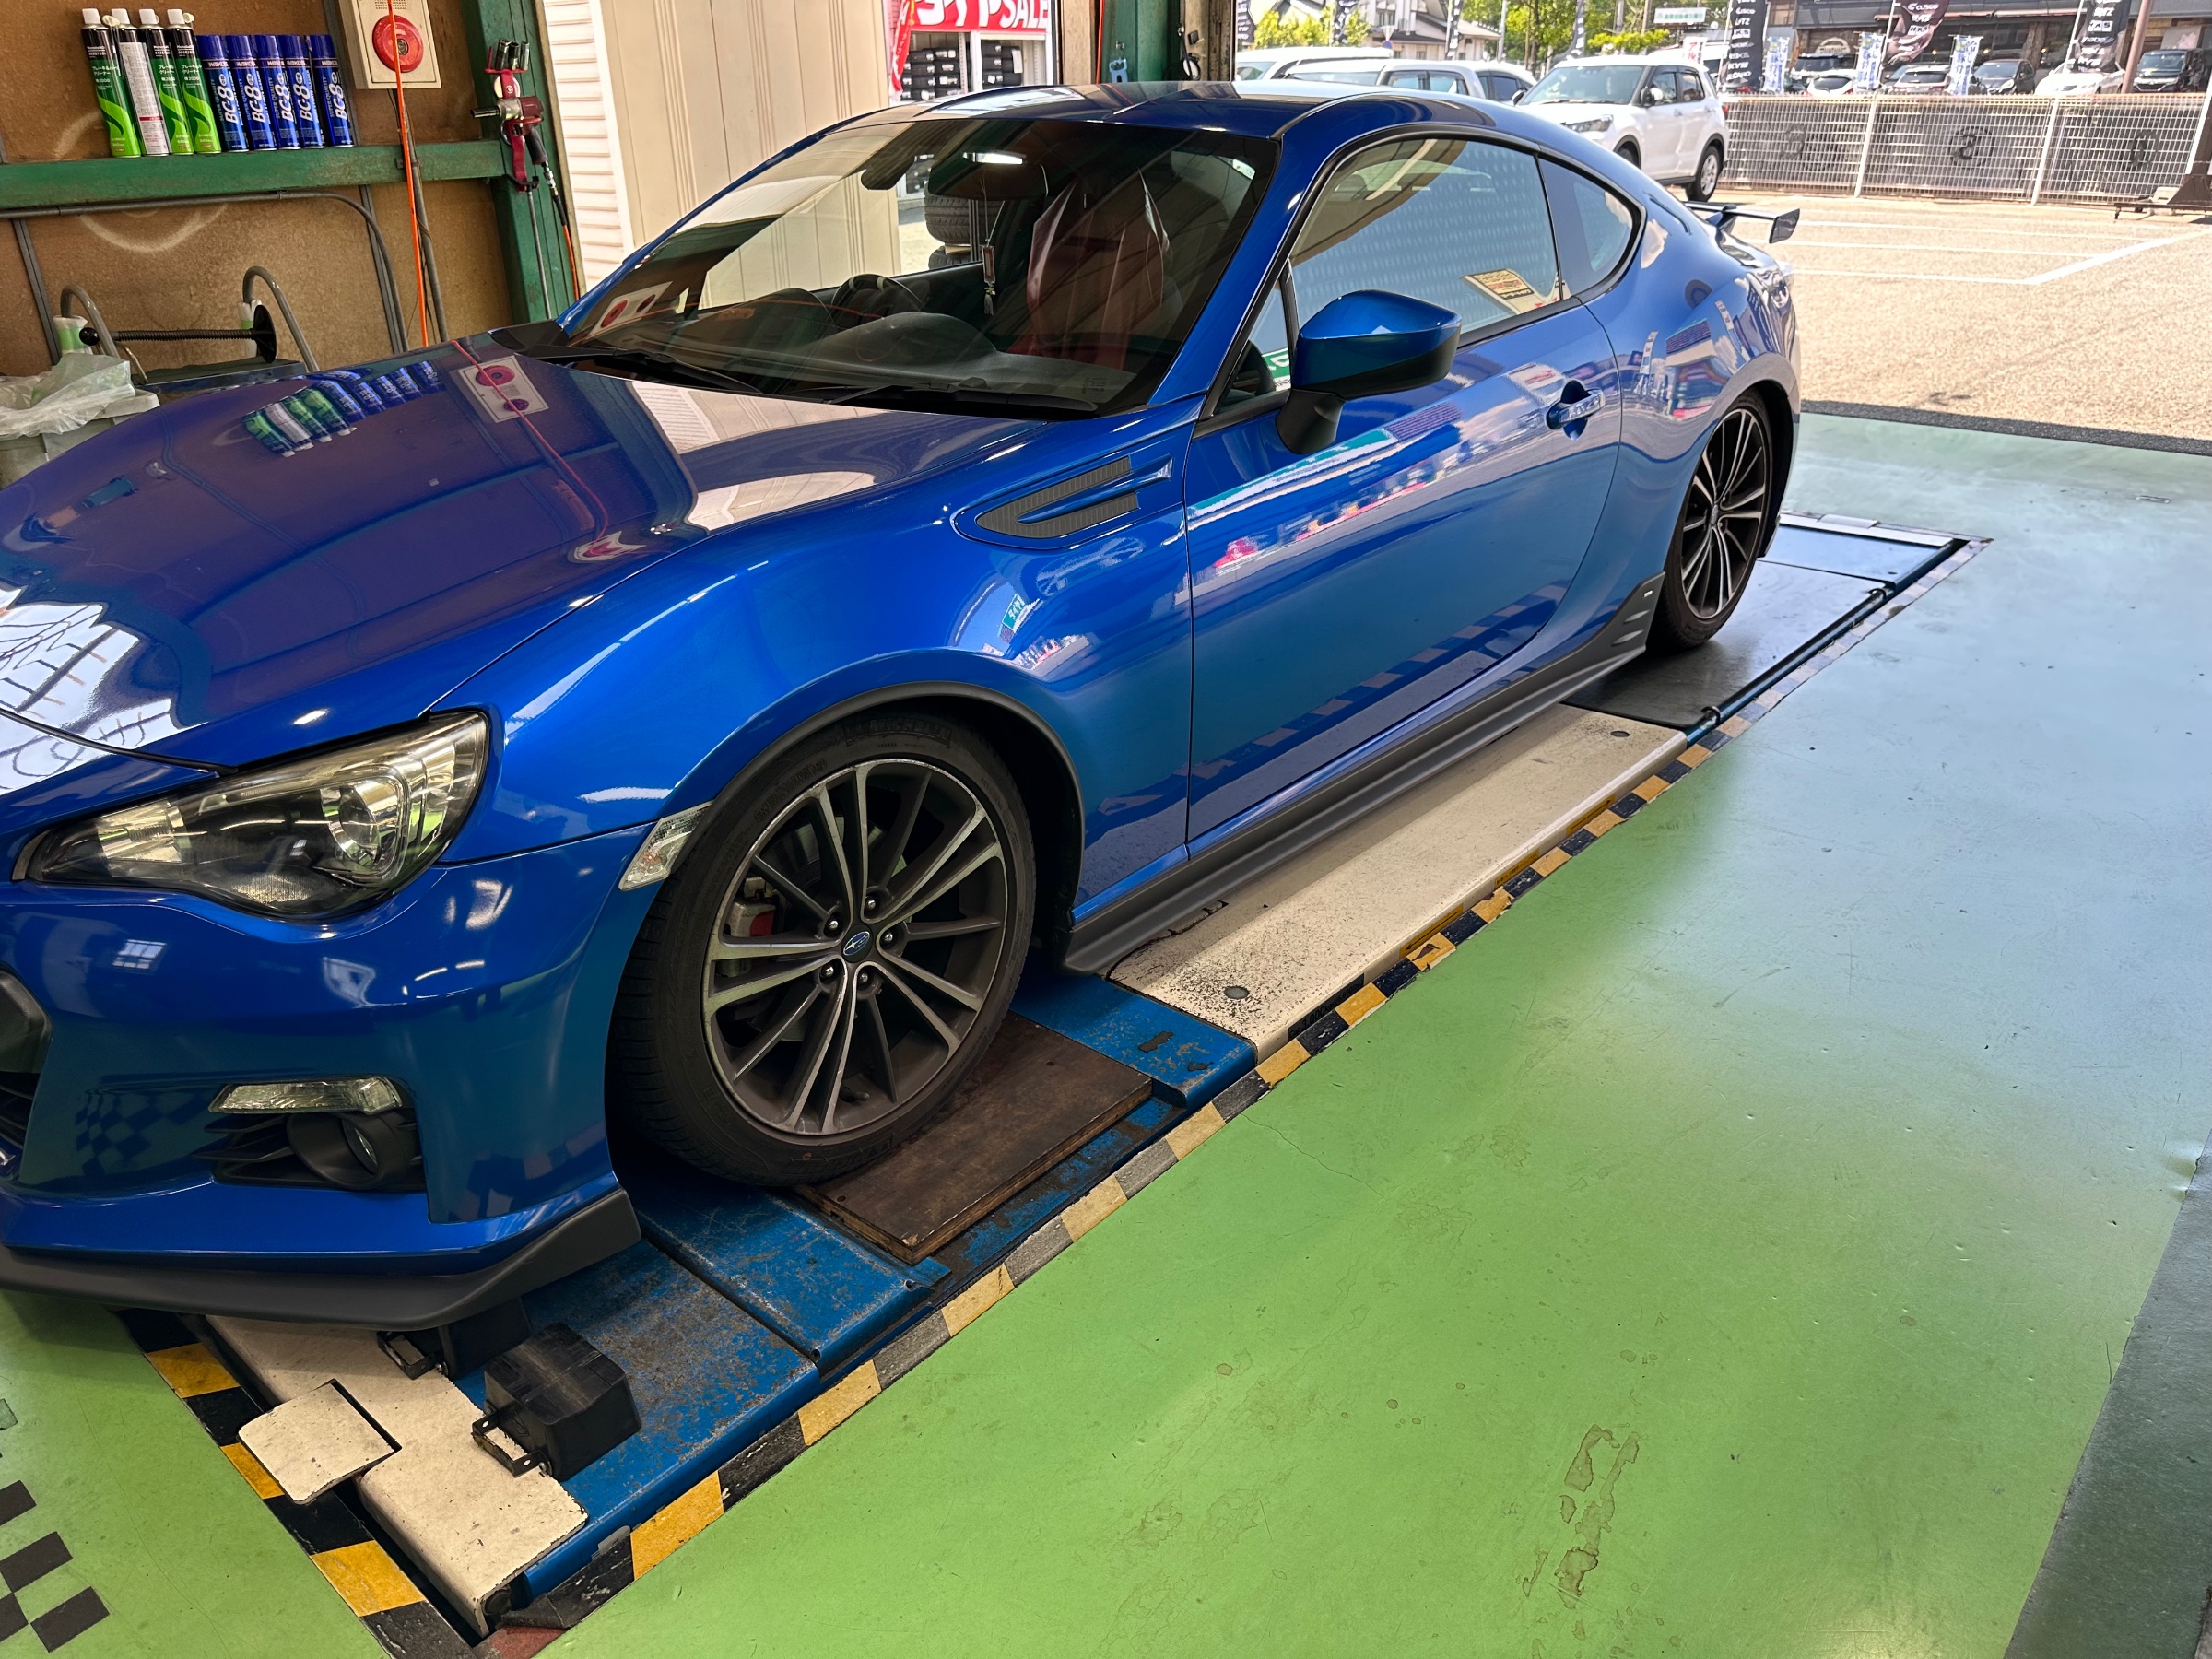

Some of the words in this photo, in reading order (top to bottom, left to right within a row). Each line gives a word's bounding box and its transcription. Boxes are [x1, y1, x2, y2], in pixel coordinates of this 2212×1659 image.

[217, 85, 239, 124] BC-8
[244, 85, 265, 123] BC-8
[275, 84, 294, 122] BC-8
[292, 83, 313, 121] BC-8
[328, 83, 348, 120] BC-8
